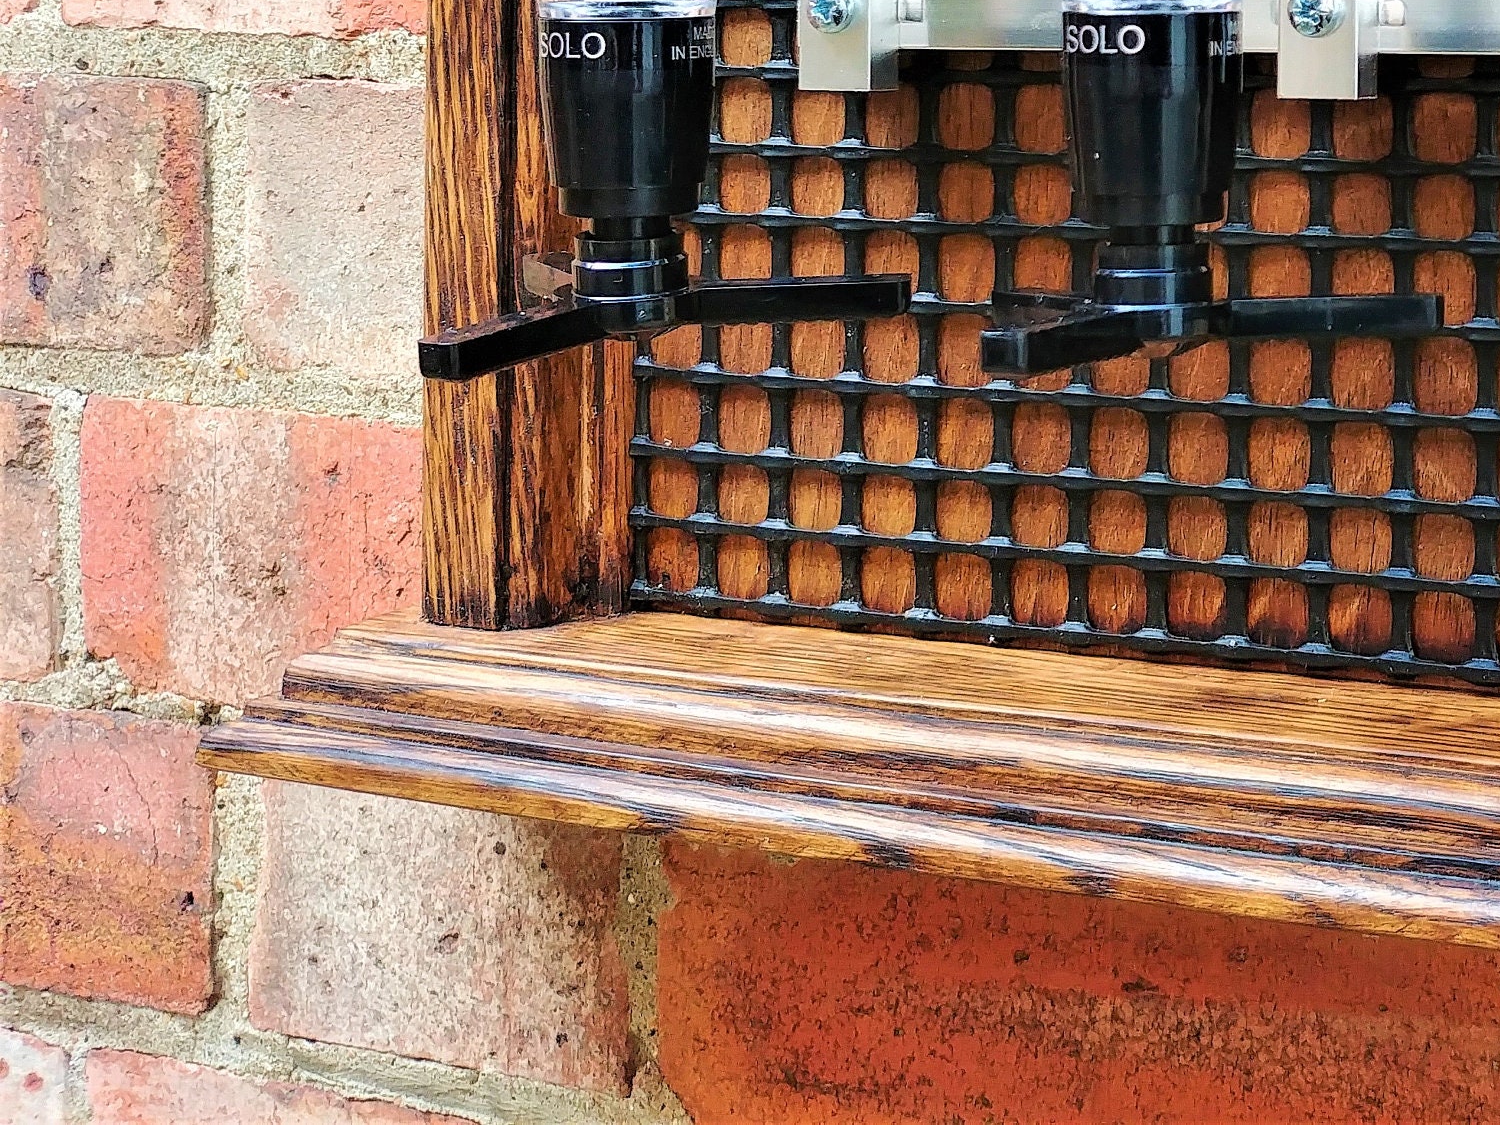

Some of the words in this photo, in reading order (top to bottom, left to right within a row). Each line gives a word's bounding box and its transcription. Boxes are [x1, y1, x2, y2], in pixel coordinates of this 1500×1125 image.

[540, 32, 606, 59] SOLO
[671, 45, 686, 60] IN
[1066, 24, 1146, 55] SOLO
